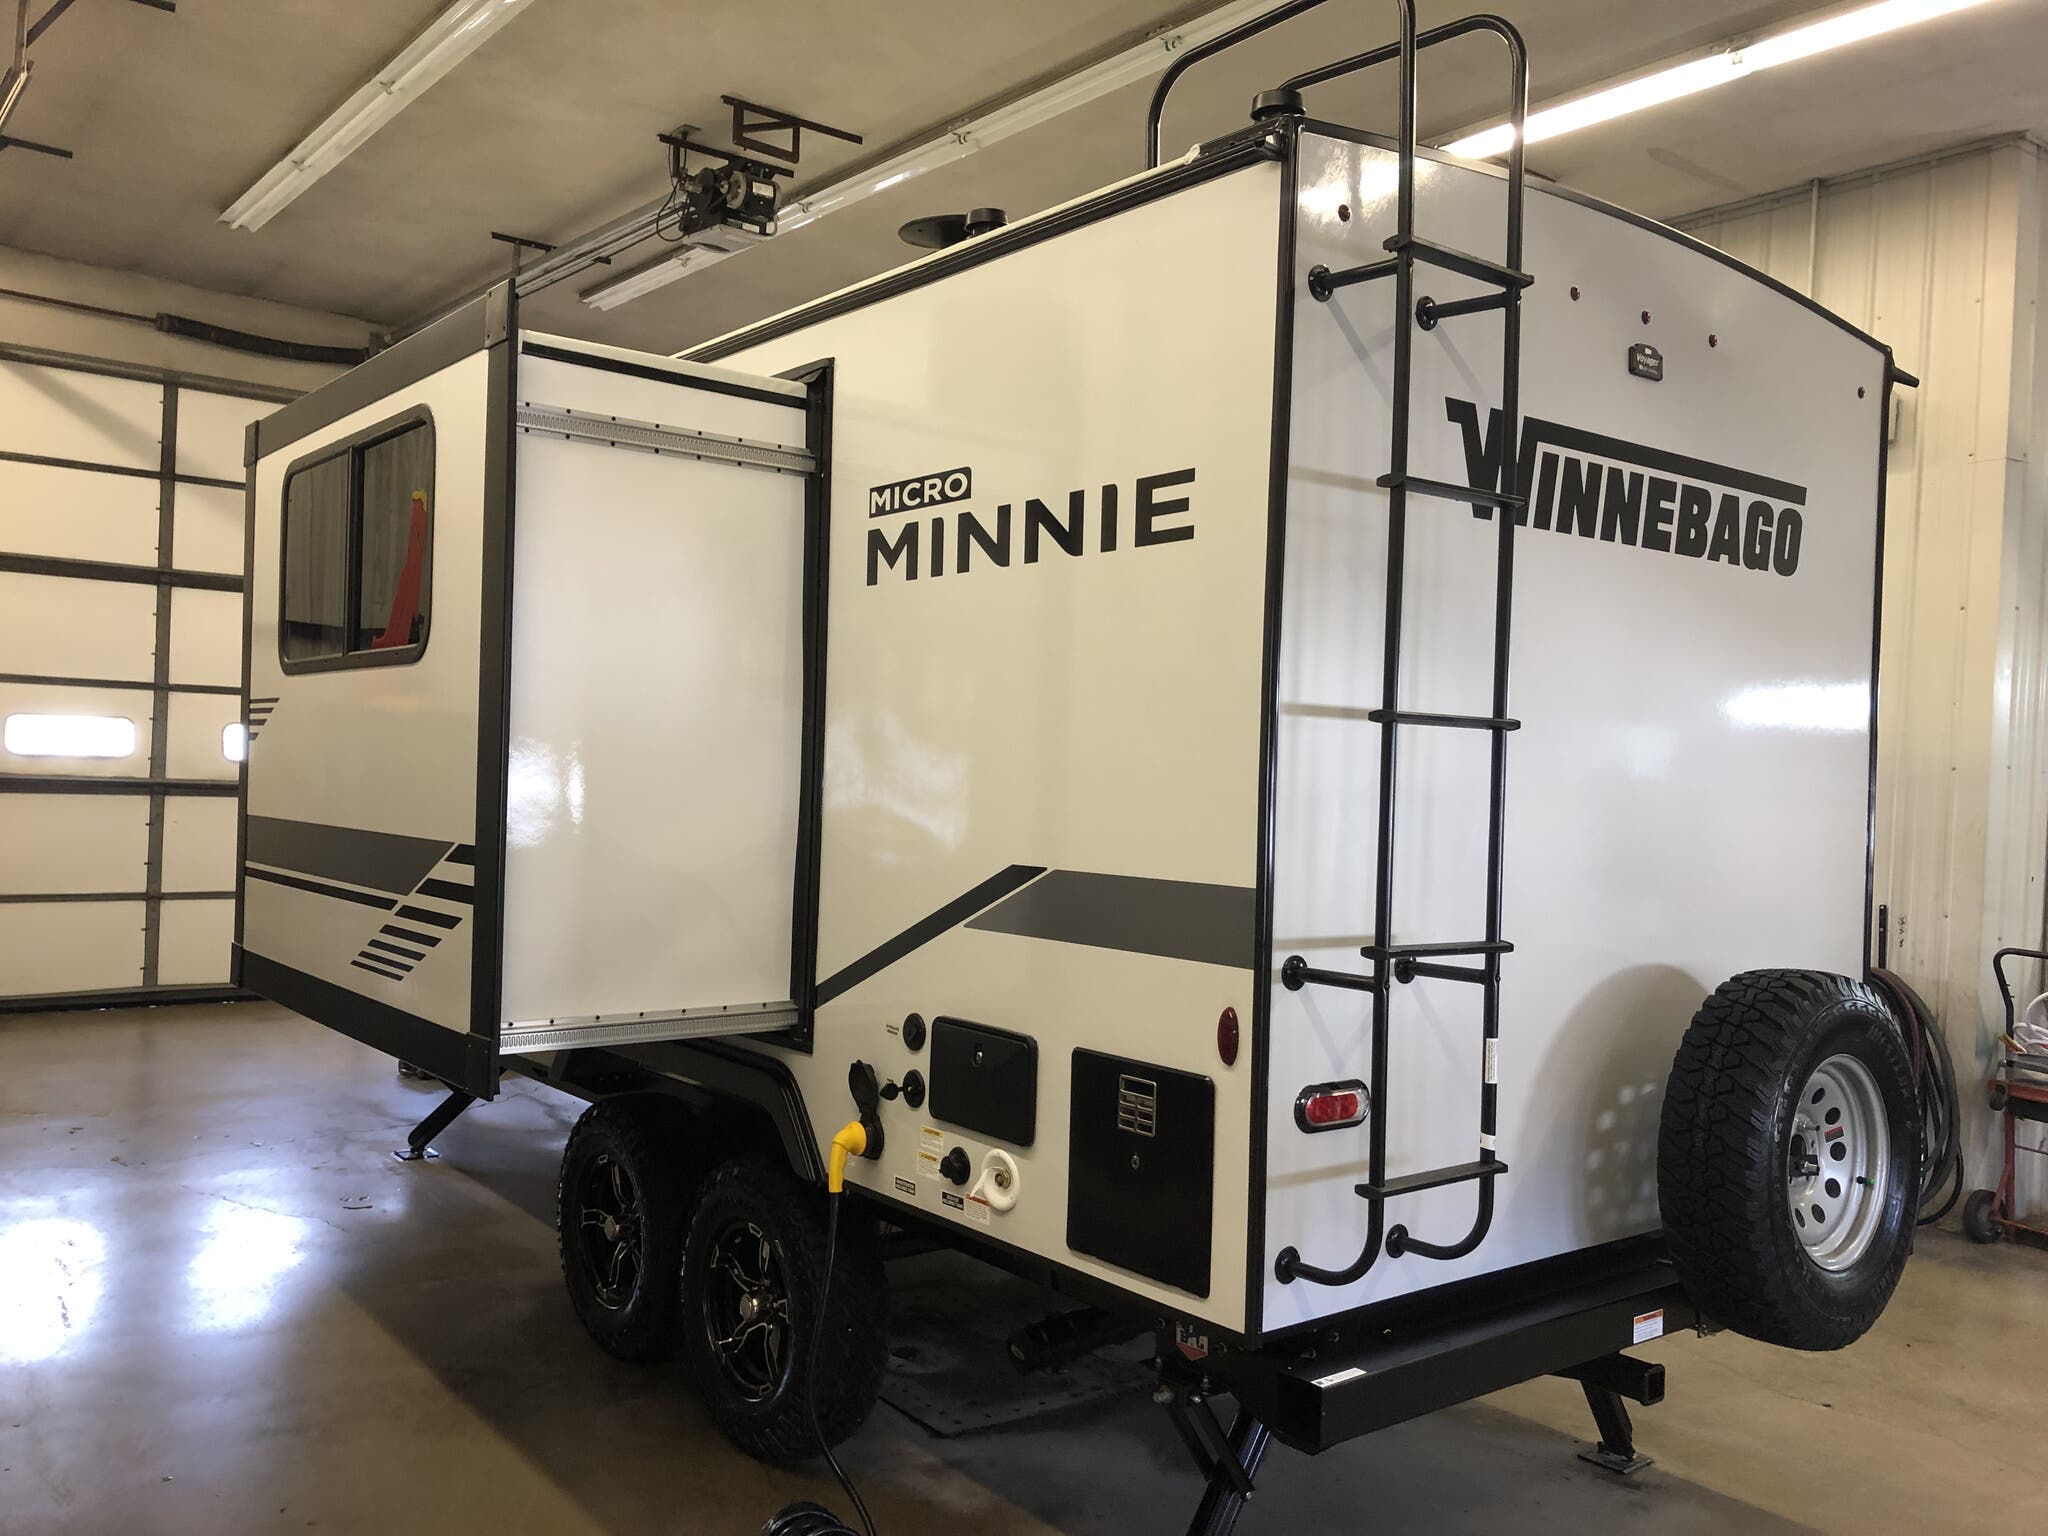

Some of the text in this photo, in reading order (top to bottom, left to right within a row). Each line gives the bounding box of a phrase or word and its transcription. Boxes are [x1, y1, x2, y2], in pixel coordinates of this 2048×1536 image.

[866, 467, 1196, 587] MINNIE
[870, 471, 969, 514] MICRO
[1445, 396, 1807, 577] WINNEBAGO
